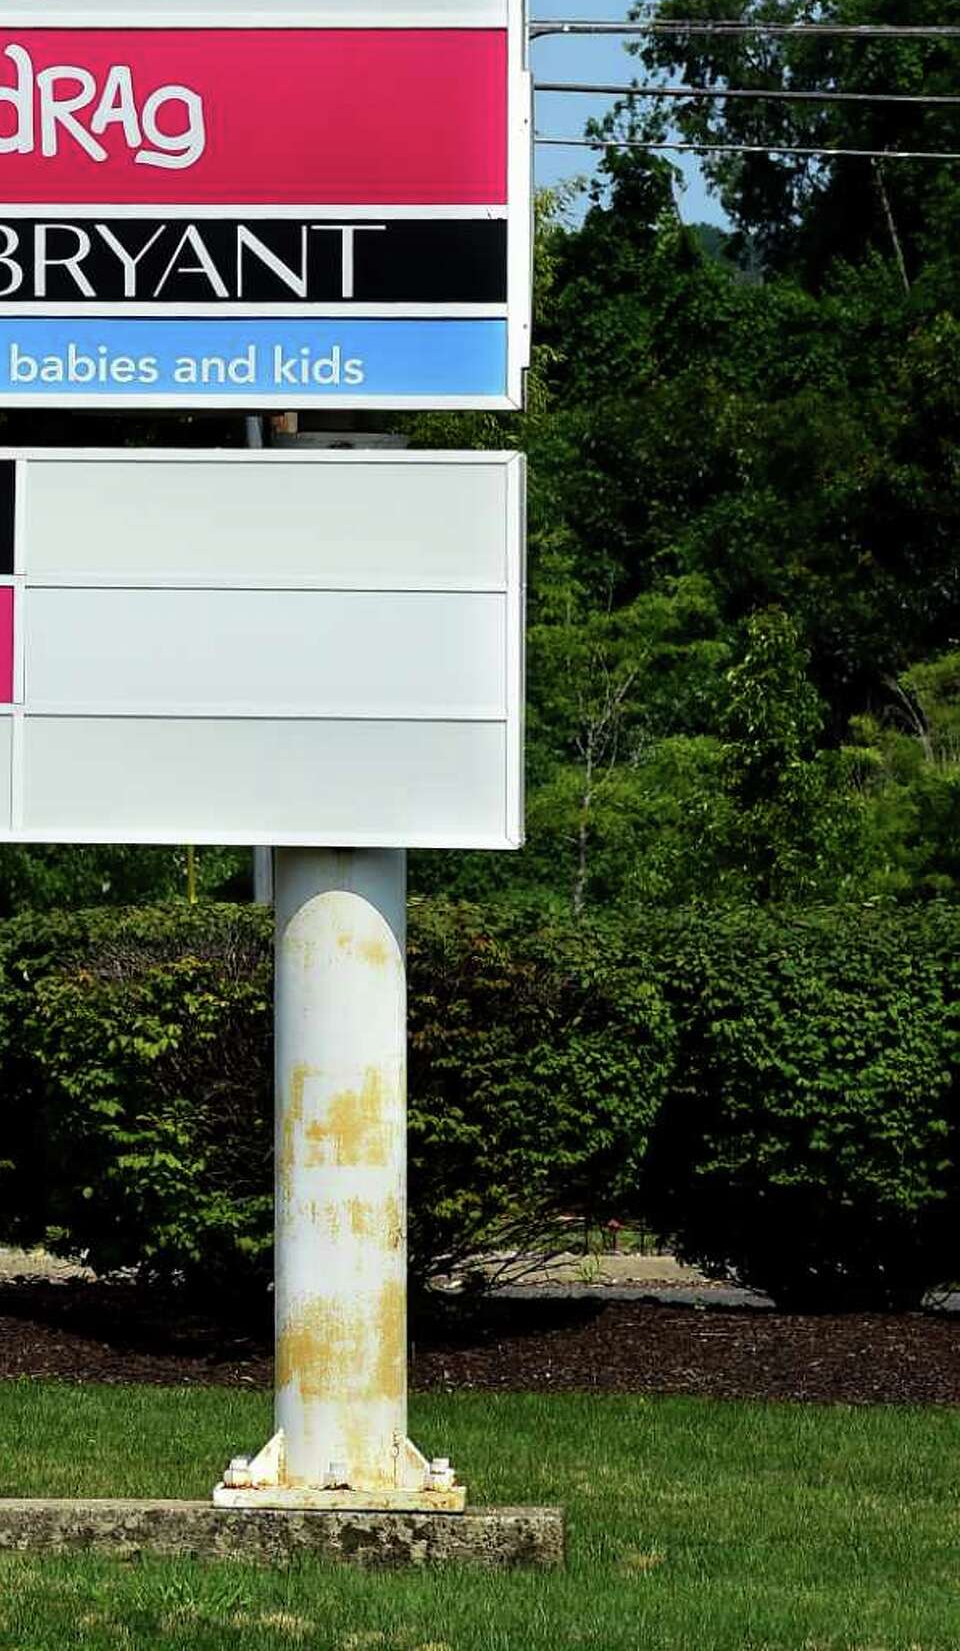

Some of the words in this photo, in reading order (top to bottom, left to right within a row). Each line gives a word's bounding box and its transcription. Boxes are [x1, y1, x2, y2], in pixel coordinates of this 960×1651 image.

[10, 343, 159, 383] babies
[173, 344, 256, 384] and
[274, 344, 364, 385] kids
